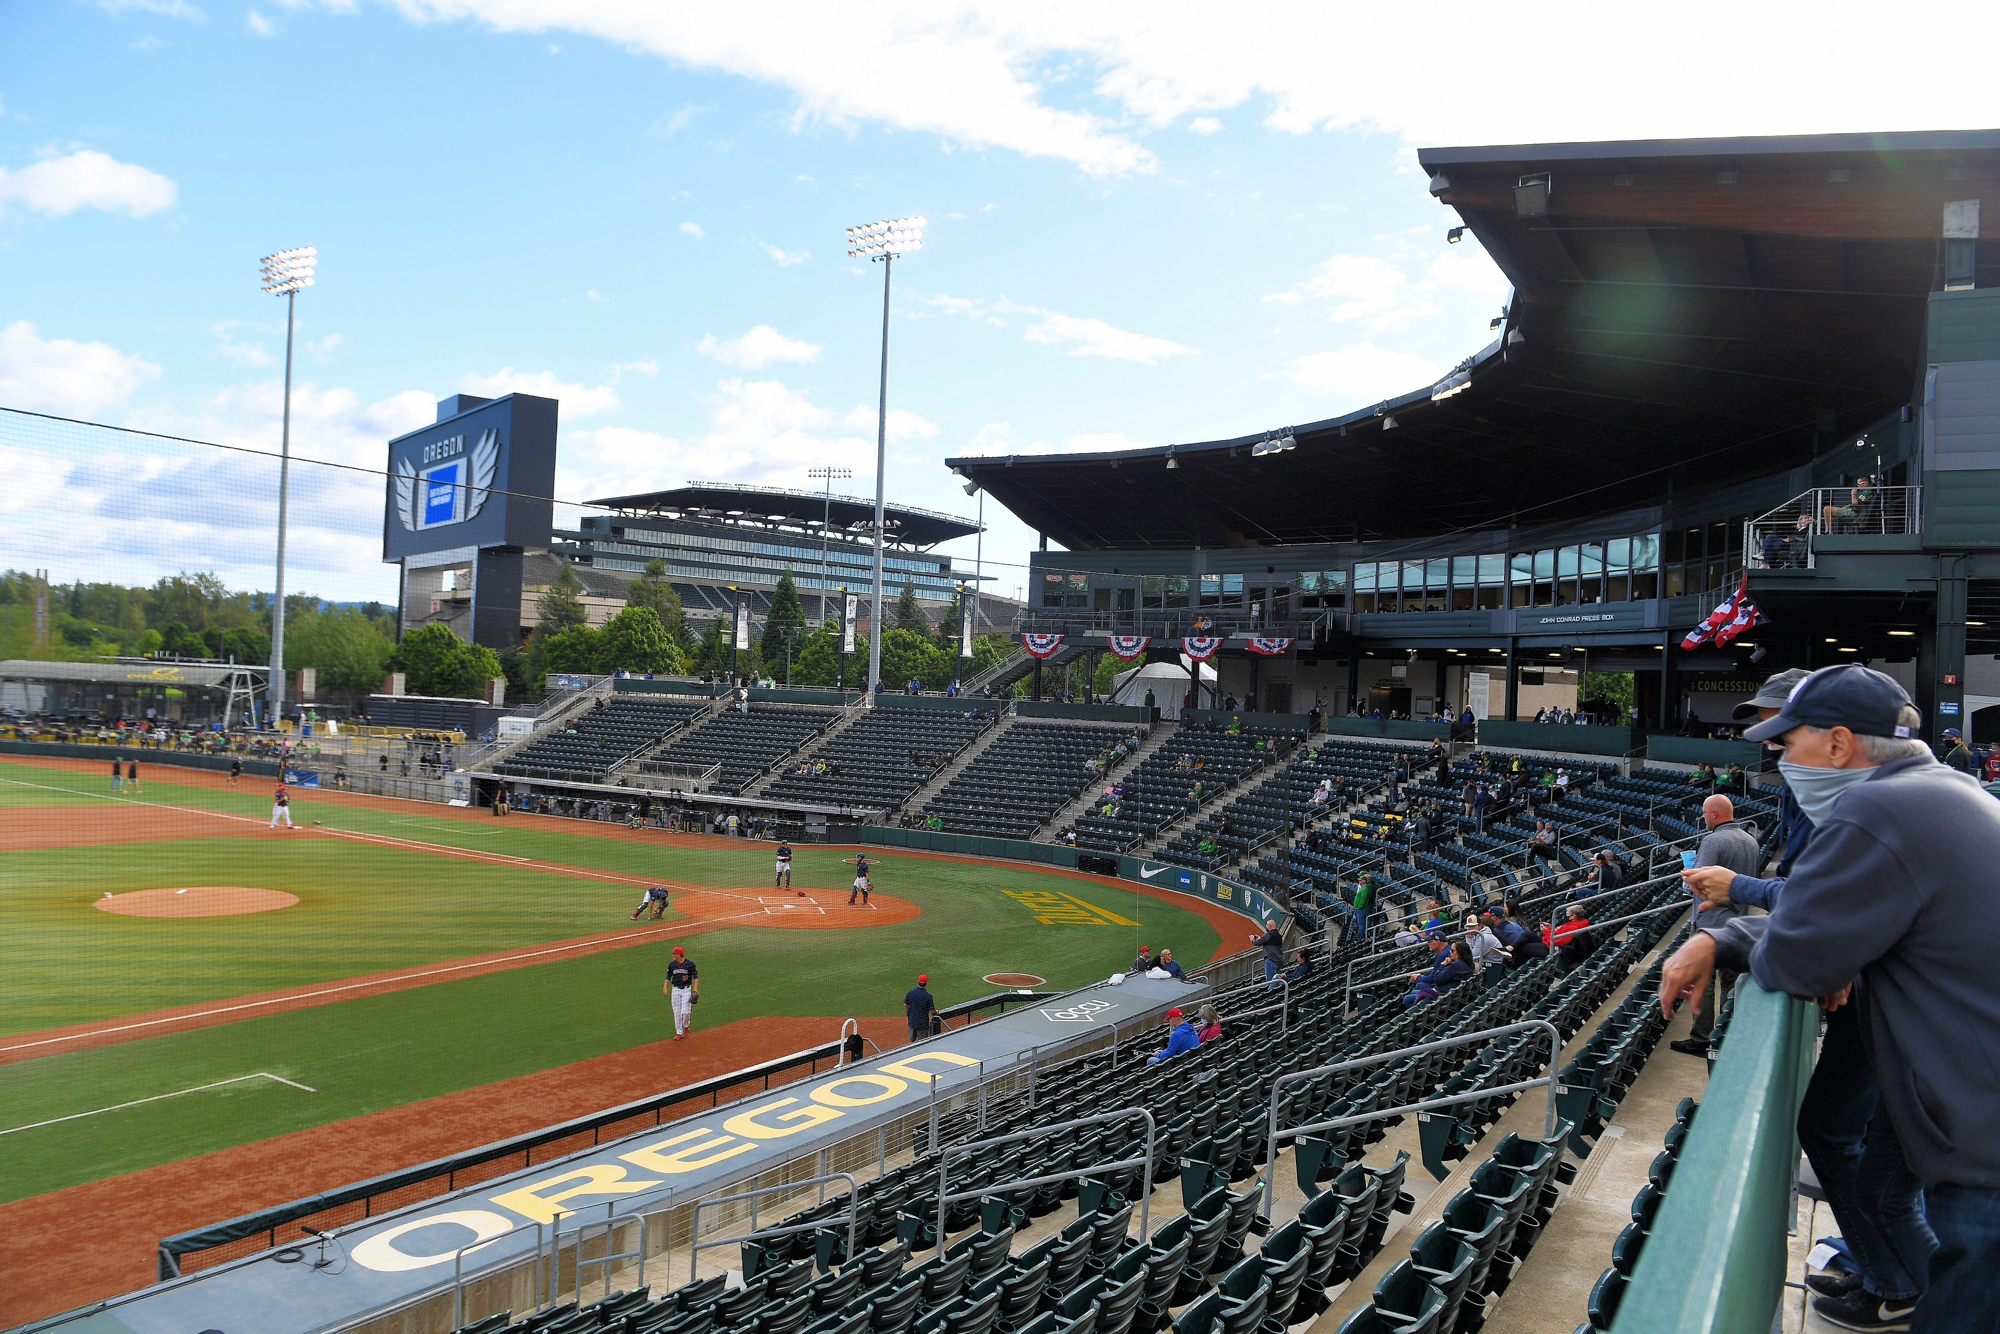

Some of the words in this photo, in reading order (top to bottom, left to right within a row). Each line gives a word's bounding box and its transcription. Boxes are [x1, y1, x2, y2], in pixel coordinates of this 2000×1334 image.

[423, 434, 464, 464] OREGON
[1581, 614, 1600, 622] PRESS
[1697, 680, 1764, 692] CONCESSION
[350, 1051, 982, 1272] OREGON
